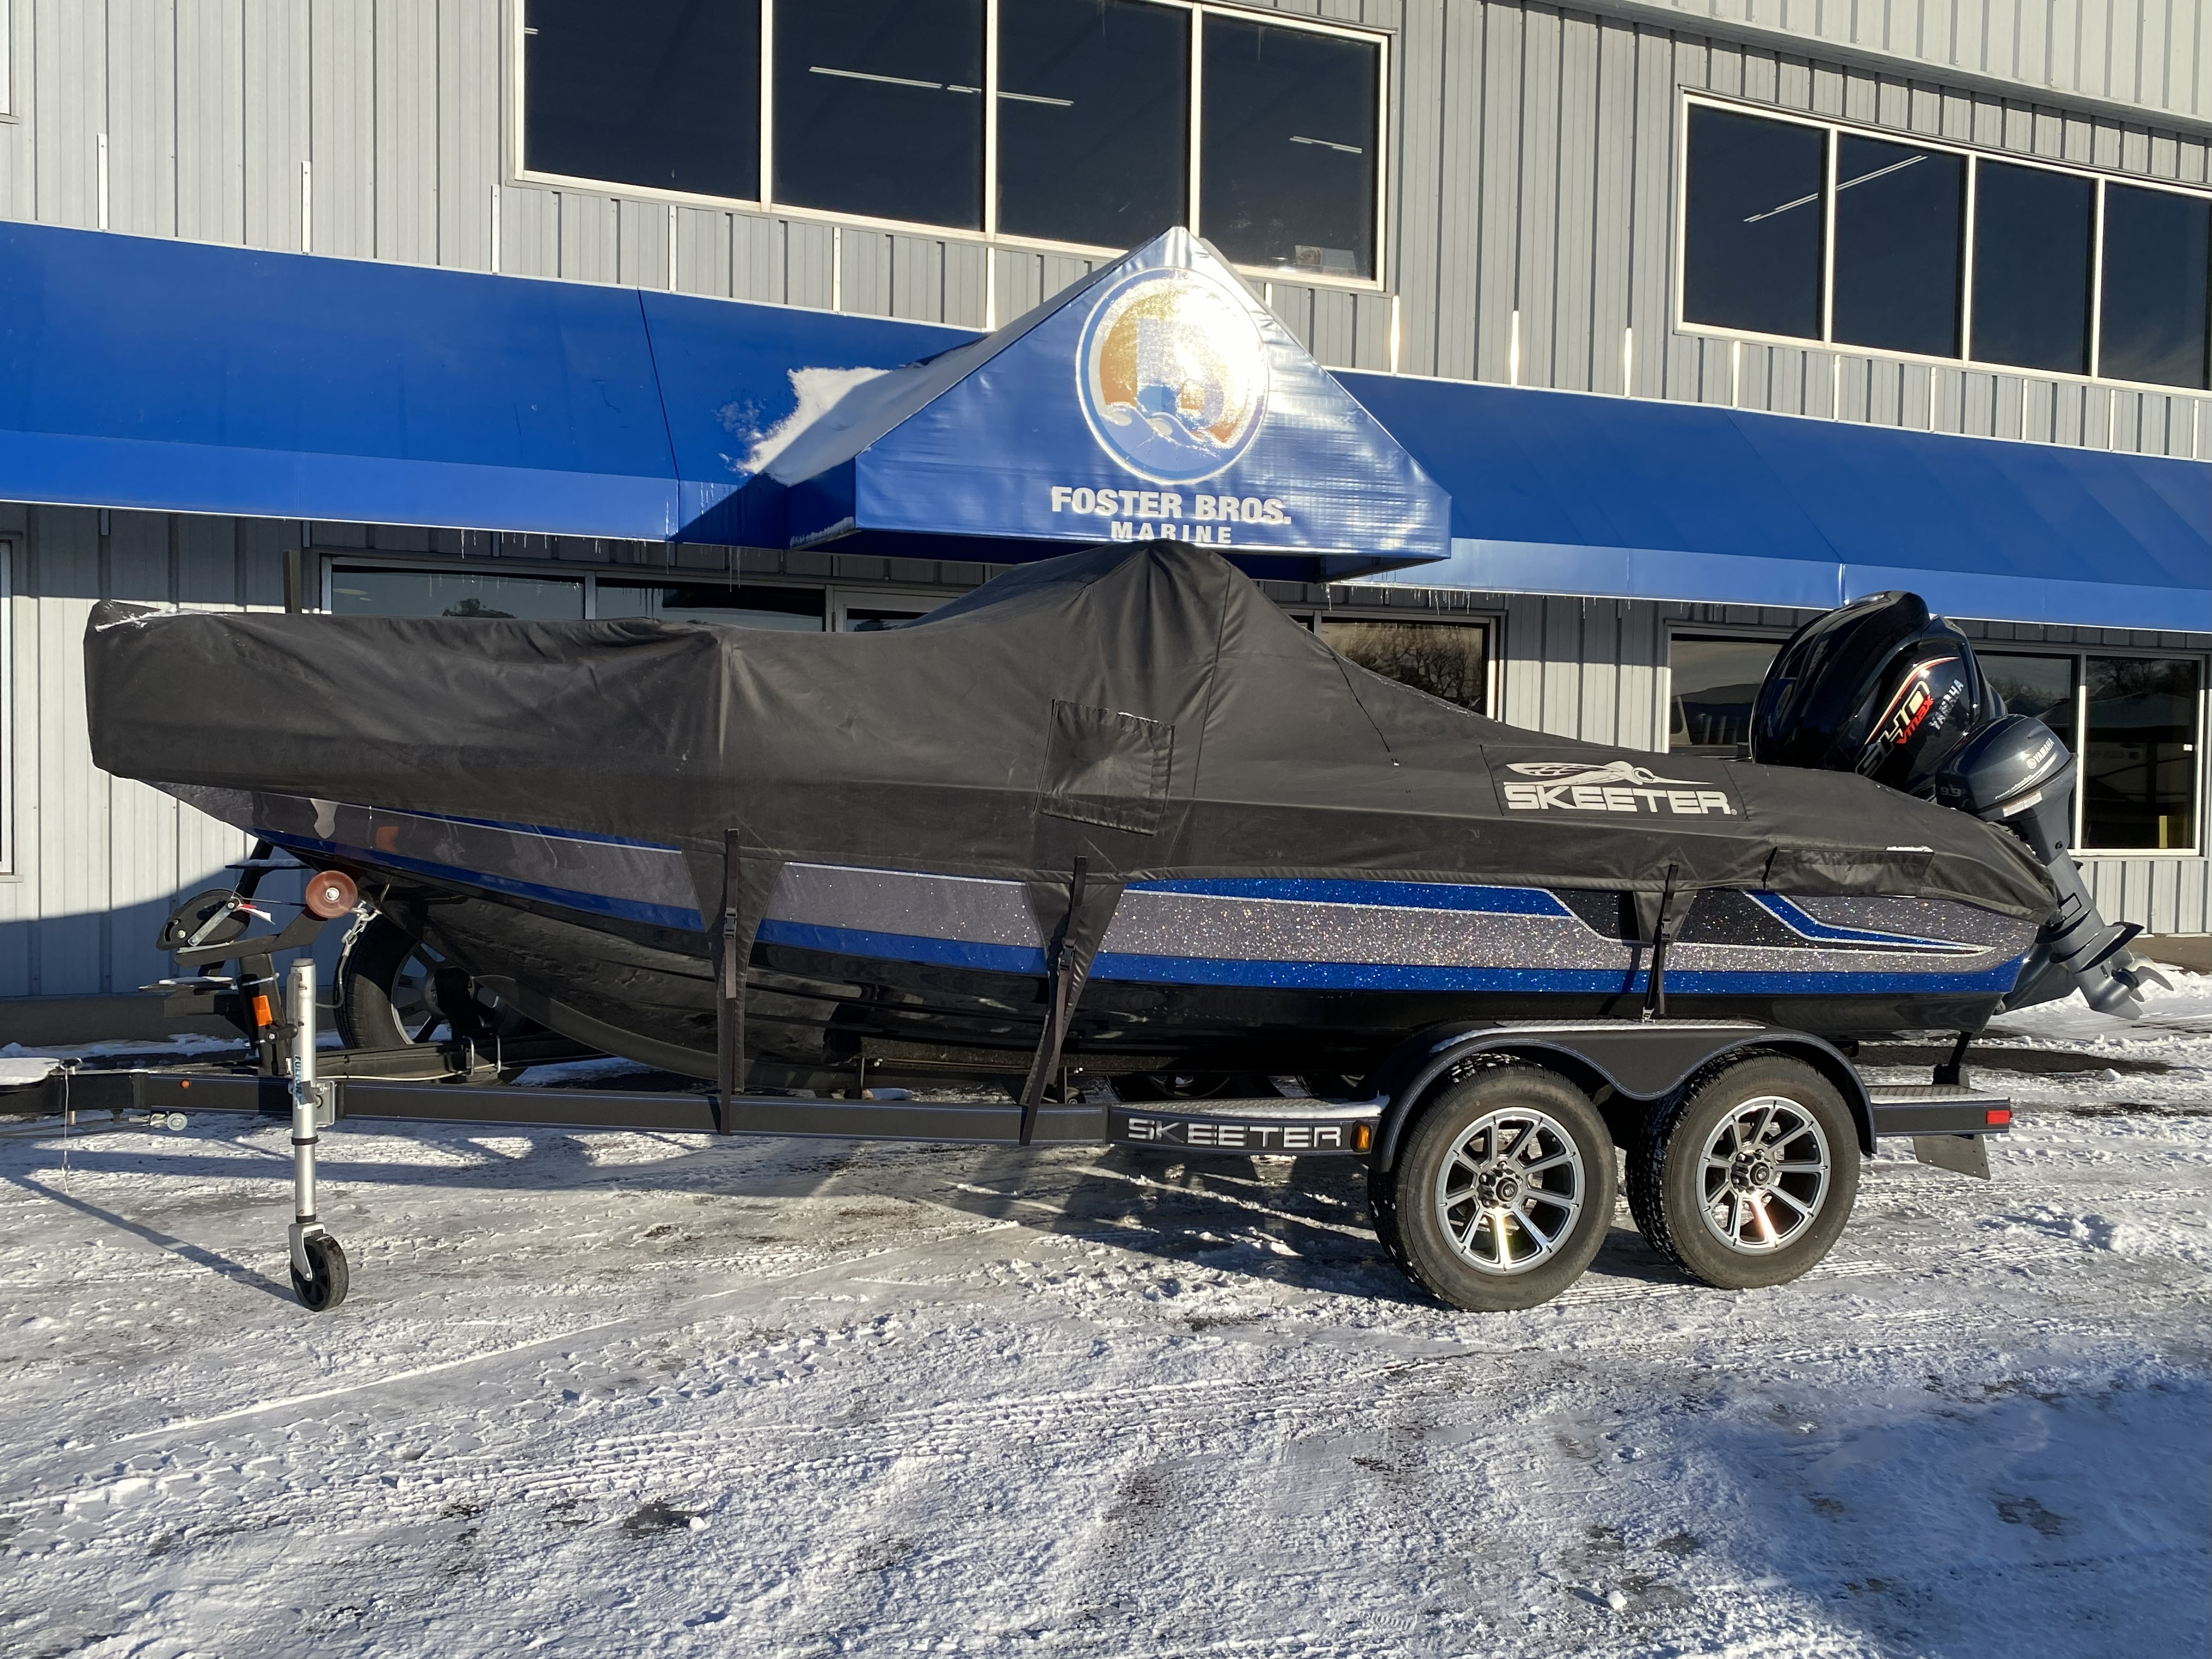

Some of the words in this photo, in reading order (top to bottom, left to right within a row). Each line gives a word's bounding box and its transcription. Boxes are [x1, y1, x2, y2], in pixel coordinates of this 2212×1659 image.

[1051, 486, 1182, 518] FOSTER
[1195, 494, 1291, 524] BROS.
[1111, 521, 1232, 544] MARINE
[1928, 679, 1964, 730] YAMAHA
[2032, 737, 2055, 763] YAMAHA
[1503, 784, 1731, 815] SKEETER
[1940, 786, 1962, 797] 9.9
[1128, 1118, 1342, 1148] SKEETER
